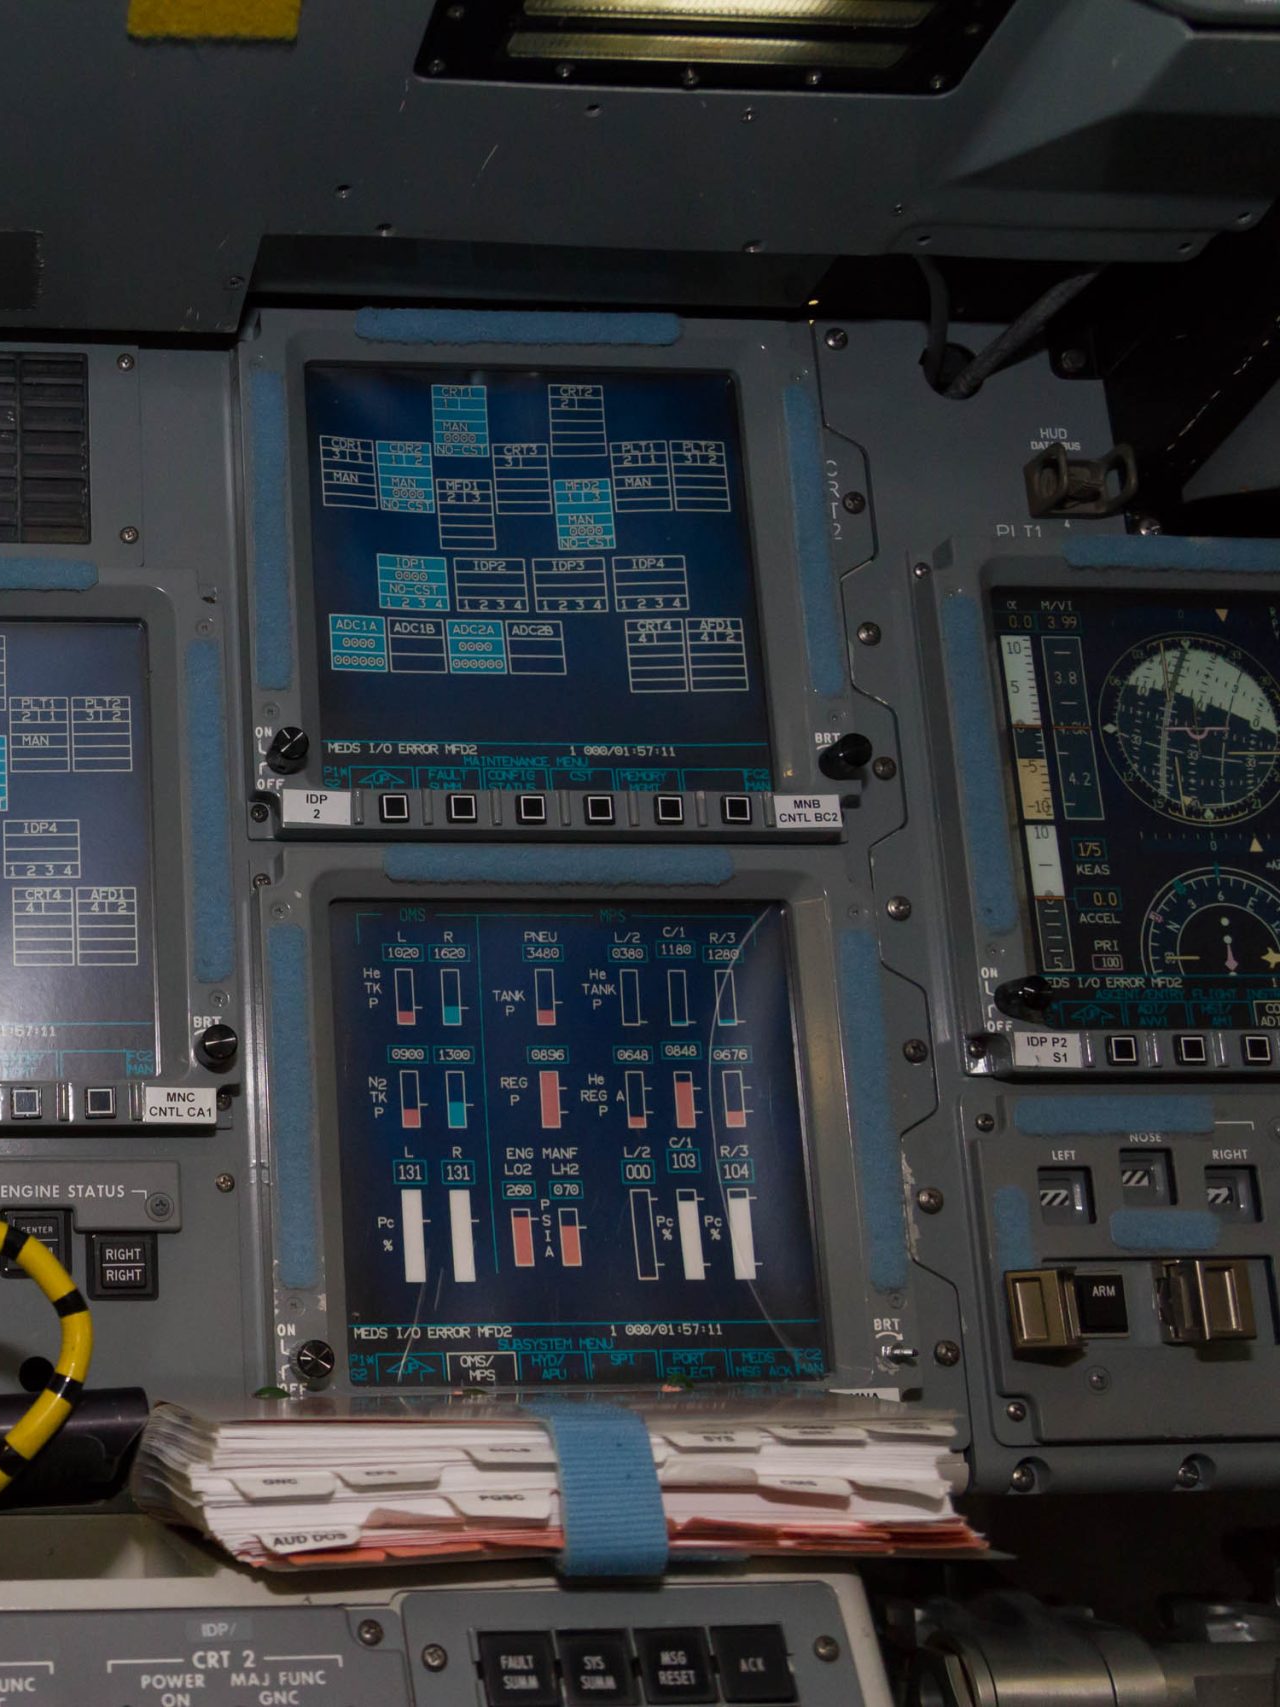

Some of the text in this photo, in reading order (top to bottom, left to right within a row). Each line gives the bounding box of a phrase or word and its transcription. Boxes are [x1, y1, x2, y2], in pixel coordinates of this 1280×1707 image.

[1040, 428, 1068, 439] HUD
[473, 561, 506, 571] IDP2
[453, 624, 495, 635] ADC2A
[255, 727, 273, 738] ON
[814, 732, 841, 743] BRT
[328, 742, 478, 755] MEDS I/O ERROR MFD2
[257, 779, 284, 790] OFF
[306, 794, 328, 805] IDP
[793, 799, 821, 809] MNB
[313, 809, 320, 819] 2
[779, 811, 839, 823] CNTL BC2
[23, 823, 58, 833] IDP4
[1076, 864, 1110, 875] KEAS
[91, 889, 124, 900] AFD1
[1080, 912, 1120, 924] ACCEL
[524, 932, 558, 942] PNEU
[1094, 940, 1119, 951] PRI
[981, 967, 998, 978] ON
[492, 990, 526, 1001] TANK
[193, 1016, 222, 1028] BRT
[987, 1022, 1013, 1033] OFF
[1026, 1036, 1068, 1048] IDP P2
[1053, 1052, 1069, 1062] S1
[500, 1077, 528, 1088] REG
[166, 1092, 195, 1103] MNC
[149, 1106, 212, 1118] CNTL CA1
[1130, 1133, 1162, 1143] NOSE
[506, 1148, 578, 1160] ENG MANF
[1051, 1150, 1077, 1160] LEFT
[1212, 1149, 1248, 1160] RIGHT
[551, 1163, 580, 1175] LH2
[0, 1185, 60, 1198] ENGINE
[68, 1185, 125, 1198] STATUS
[105, 1248, 142, 1261] RIGHT
[106, 1269, 142, 1281] RIGHT
[1092, 1285, 1116, 1296] ARM
[277, 1324, 296, 1336] ON
[874, 1318, 901, 1331] BRT
[354, 1326, 512, 1339] MEDS ERROR MFD2
[273, 1535, 308, 1547] AUD
[191, 1650, 256, 1669] CRT 2
[500, 1655, 535, 1669] FAULT
[583, 1655, 606, 1669] SYS
[660, 1650, 687, 1665] MSG
[740, 1657, 766, 1672] ACK
[141, 1671, 327, 1689] POWER MAJ FUNC
[503, 1675, 539, 1689] SUMM
[580, 1675, 617, 1689] SUMM
[658, 1670, 696, 1686] RESET
[161, 1691, 299, 1707] ON GNC
